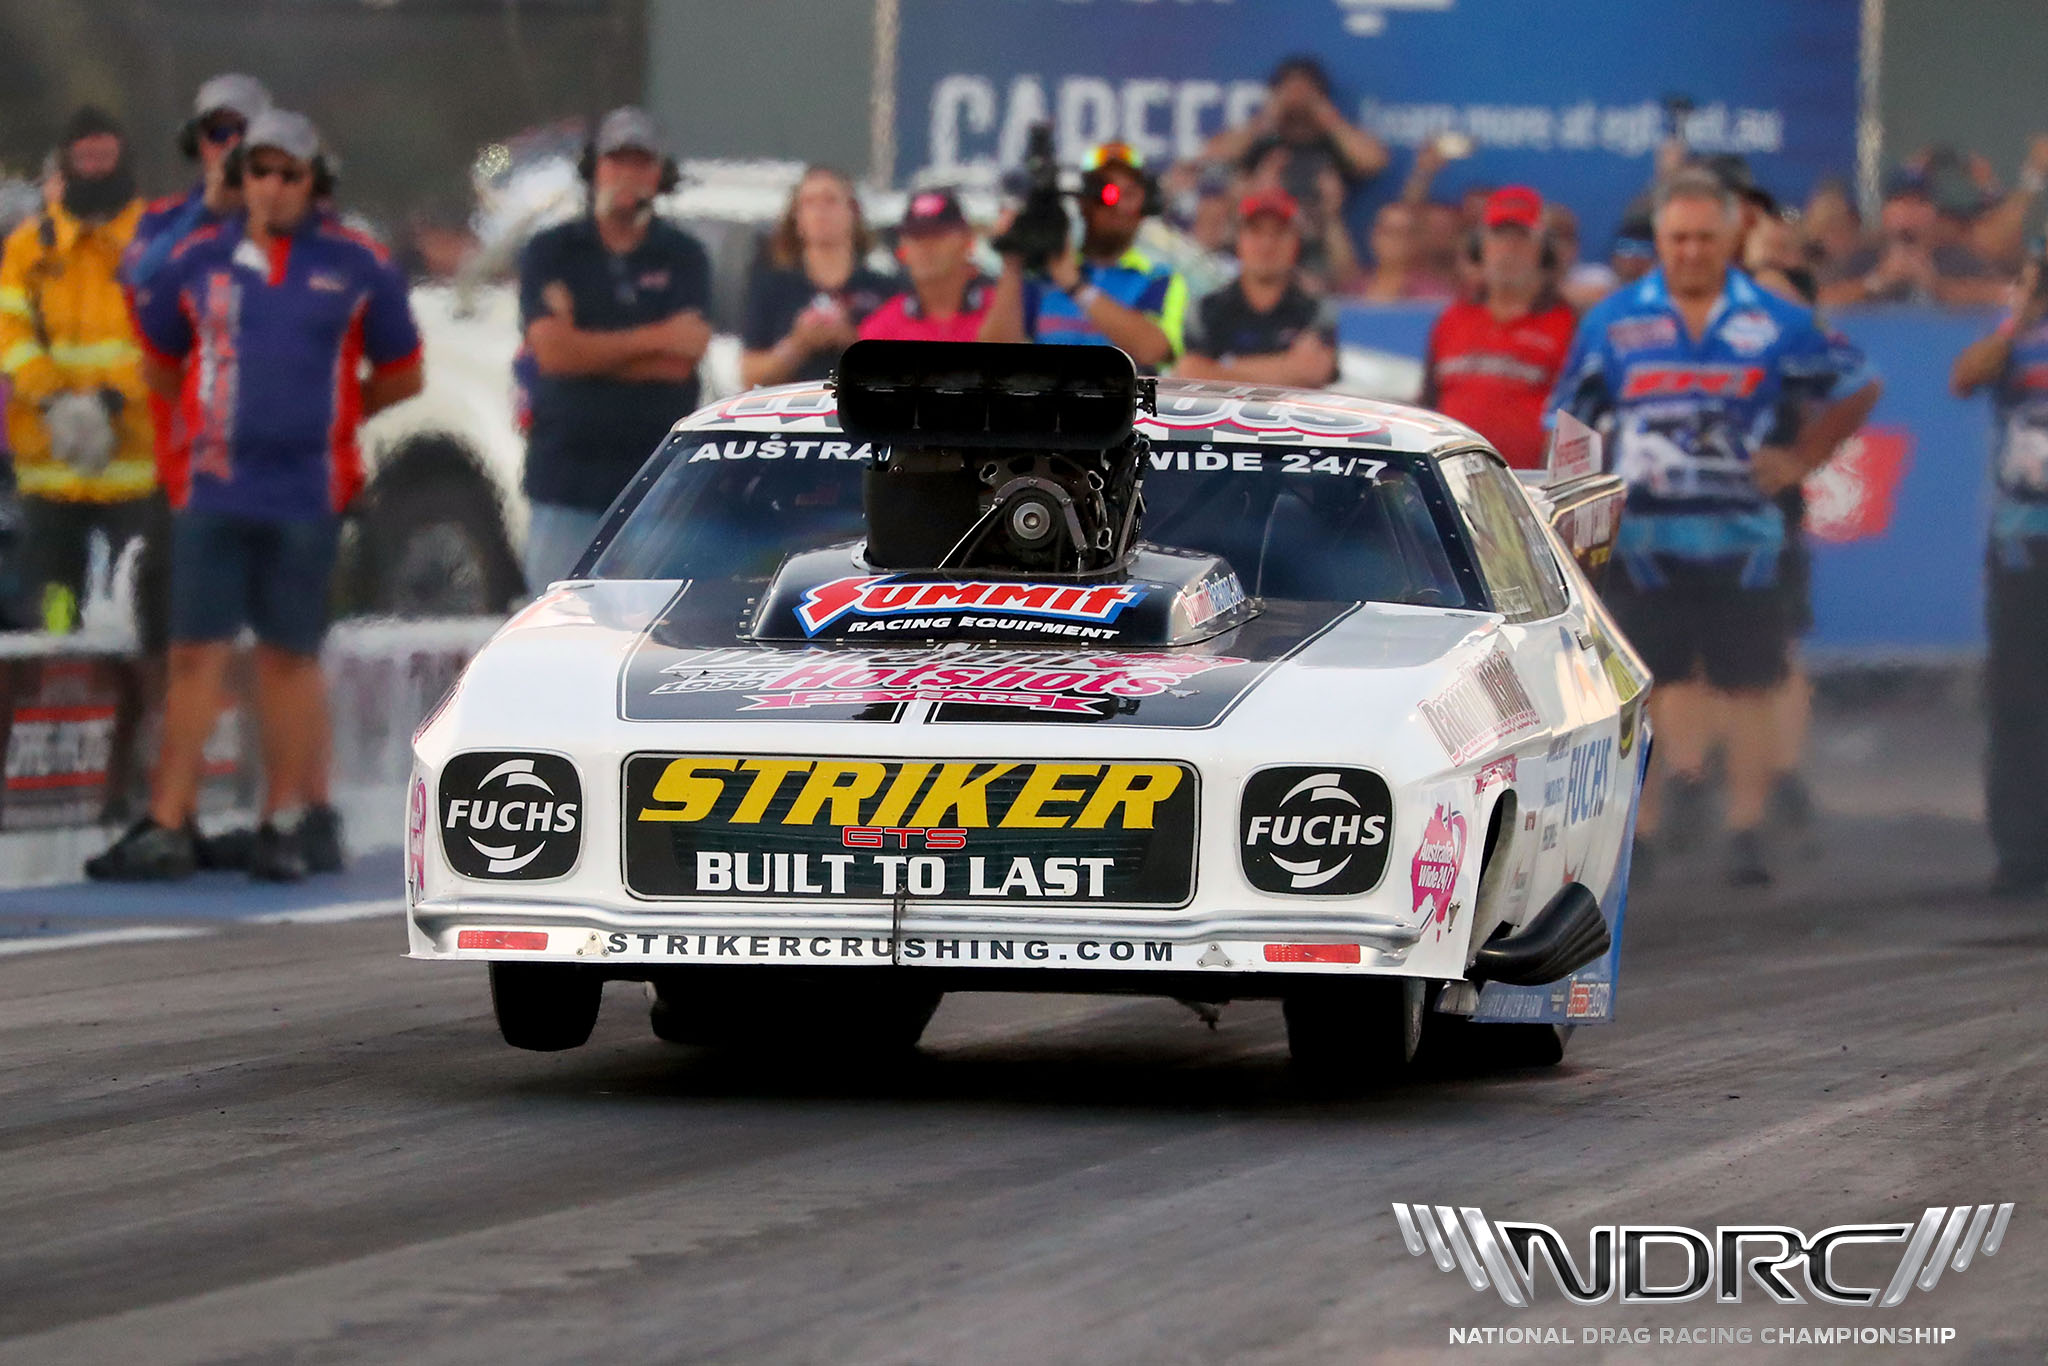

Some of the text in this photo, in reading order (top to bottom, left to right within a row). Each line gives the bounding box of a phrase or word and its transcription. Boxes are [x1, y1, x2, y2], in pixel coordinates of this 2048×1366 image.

[688, 440, 874, 463] AUSTRA
[1281, 454, 1388, 479] 24/7
[800, 575, 1140, 629] SUMMIT
[847, 615, 1120, 640] RACING EQUIPMENT
[660, 679, 765, 691] 1999
[760, 663, 1180, 697] Hotshots
[804, 691, 1042, 703] 25 YEARS
[638, 758, 1182, 830] STRIKER
[1562, 735, 1613, 828] FUCHS
[446, 798, 577, 835] FUCHS
[1247, 814, 1386, 847] FUCHS
[841, 826, 968, 849] GTS
[1418, 837, 1454, 864] Australia
[695, 851, 1115, 898] BUILT TO LAST
[607, 933, 1173, 963] STRIKERCRUSHING.COM
